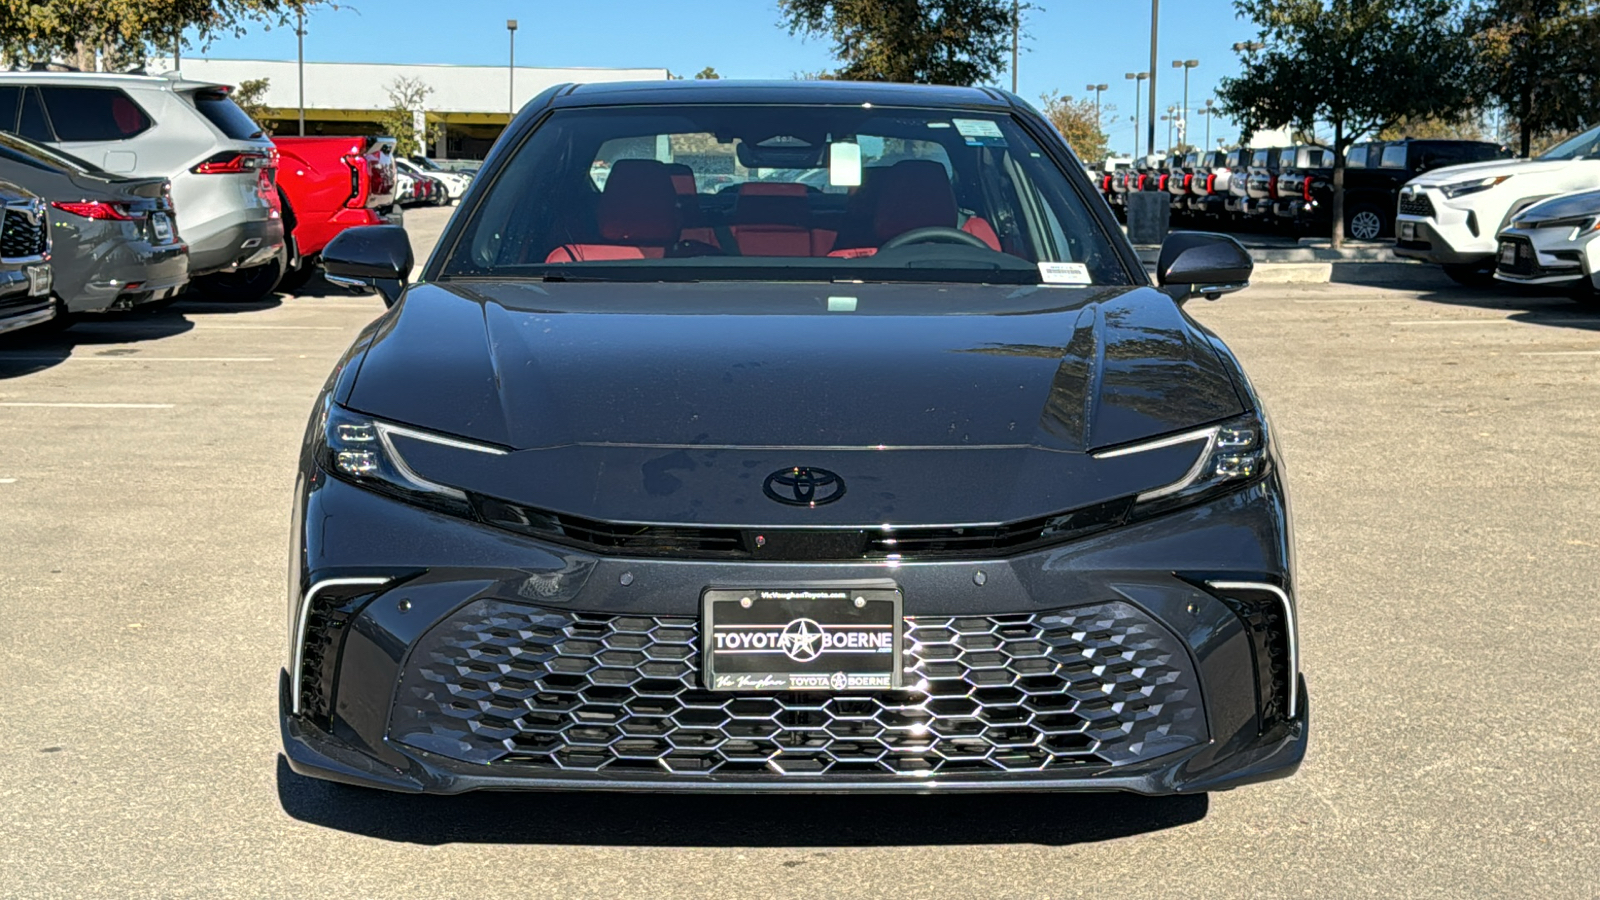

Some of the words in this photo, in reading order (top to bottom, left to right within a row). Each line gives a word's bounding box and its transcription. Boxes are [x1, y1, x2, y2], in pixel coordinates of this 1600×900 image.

[714, 632, 792, 648] TOYOTA
[822, 632, 893, 648] BOERNE
[789, 677, 830, 686] TOYOTA
[848, 677, 891, 686] BOERNE
